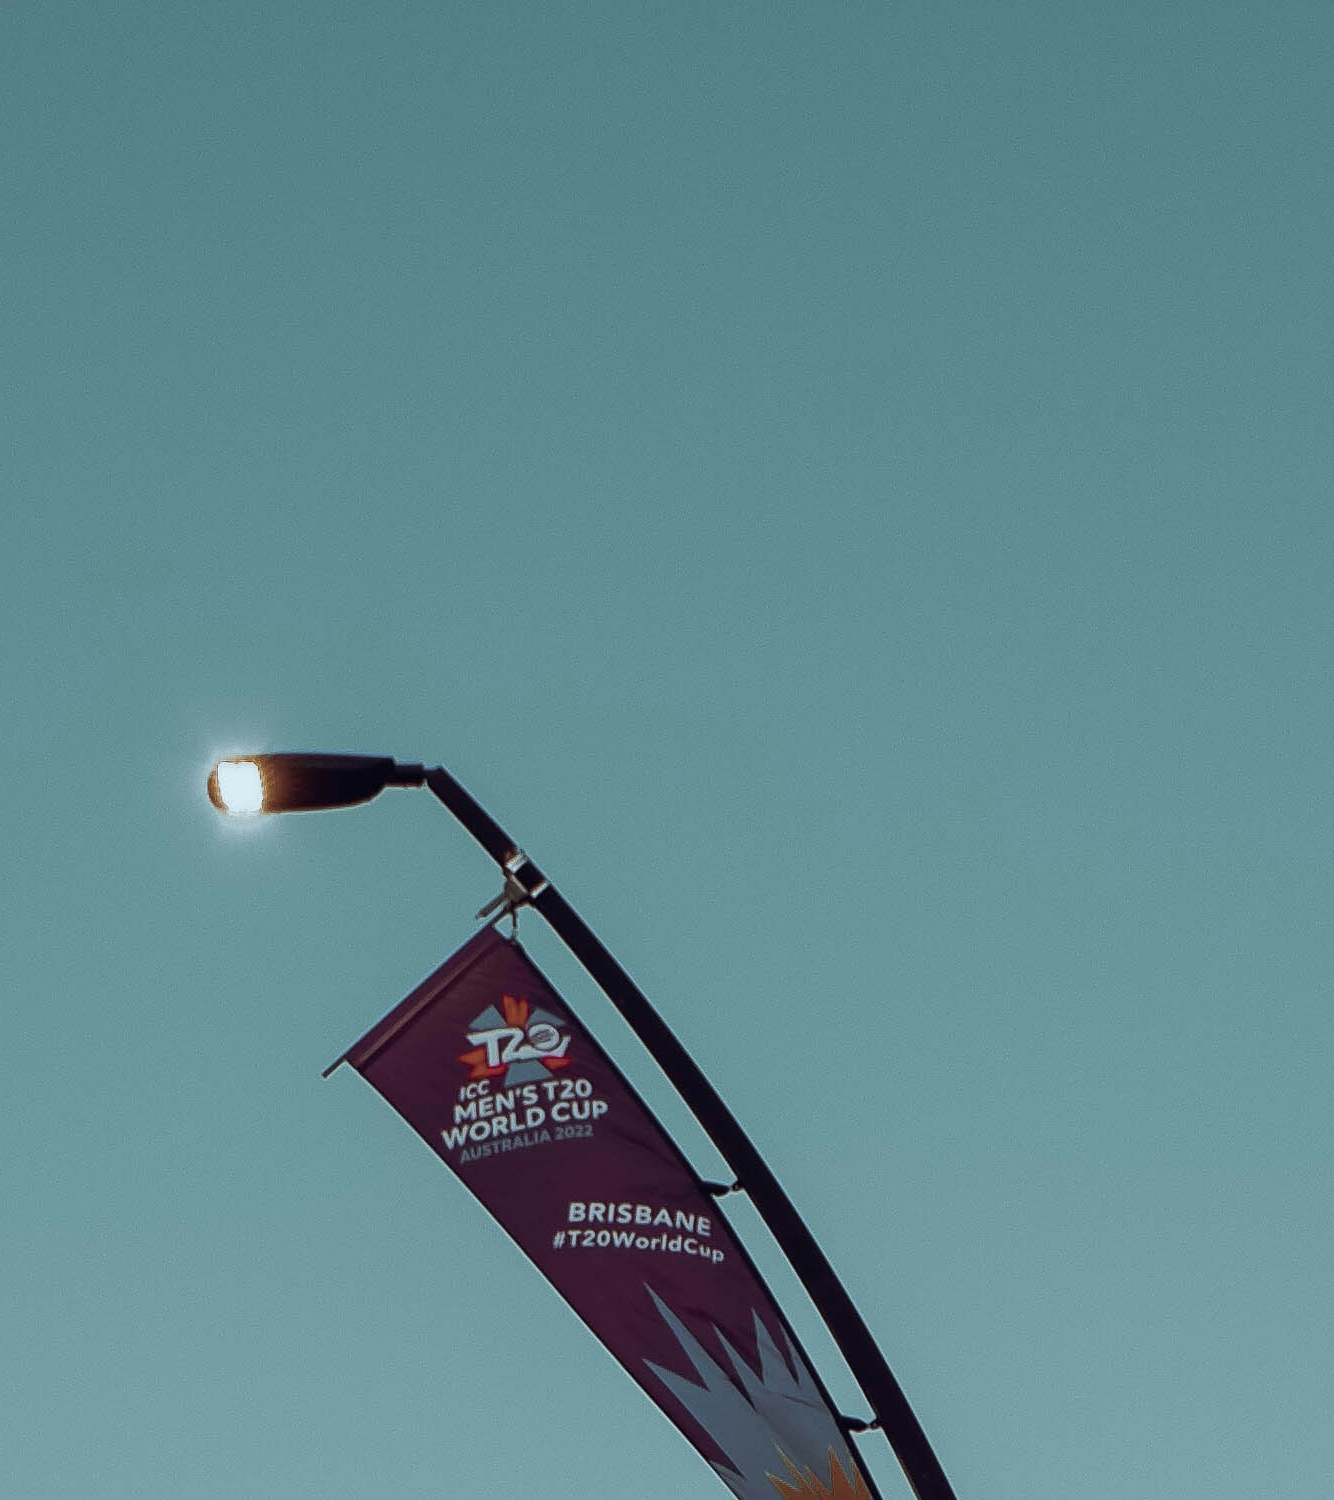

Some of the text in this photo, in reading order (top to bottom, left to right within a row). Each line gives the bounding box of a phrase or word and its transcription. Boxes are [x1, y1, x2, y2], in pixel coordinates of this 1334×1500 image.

[453, 1078, 593, 1124] MEN'S T20
[460, 1079, 491, 1101] ICC
[441, 1100, 609, 1150] WORLD CUP
[459, 1124, 594, 1164] AUSTRALIA 2022
[569, 1202, 711, 1237] BRISBANE
[553, 1230, 725, 1264] #T20WorldCup
